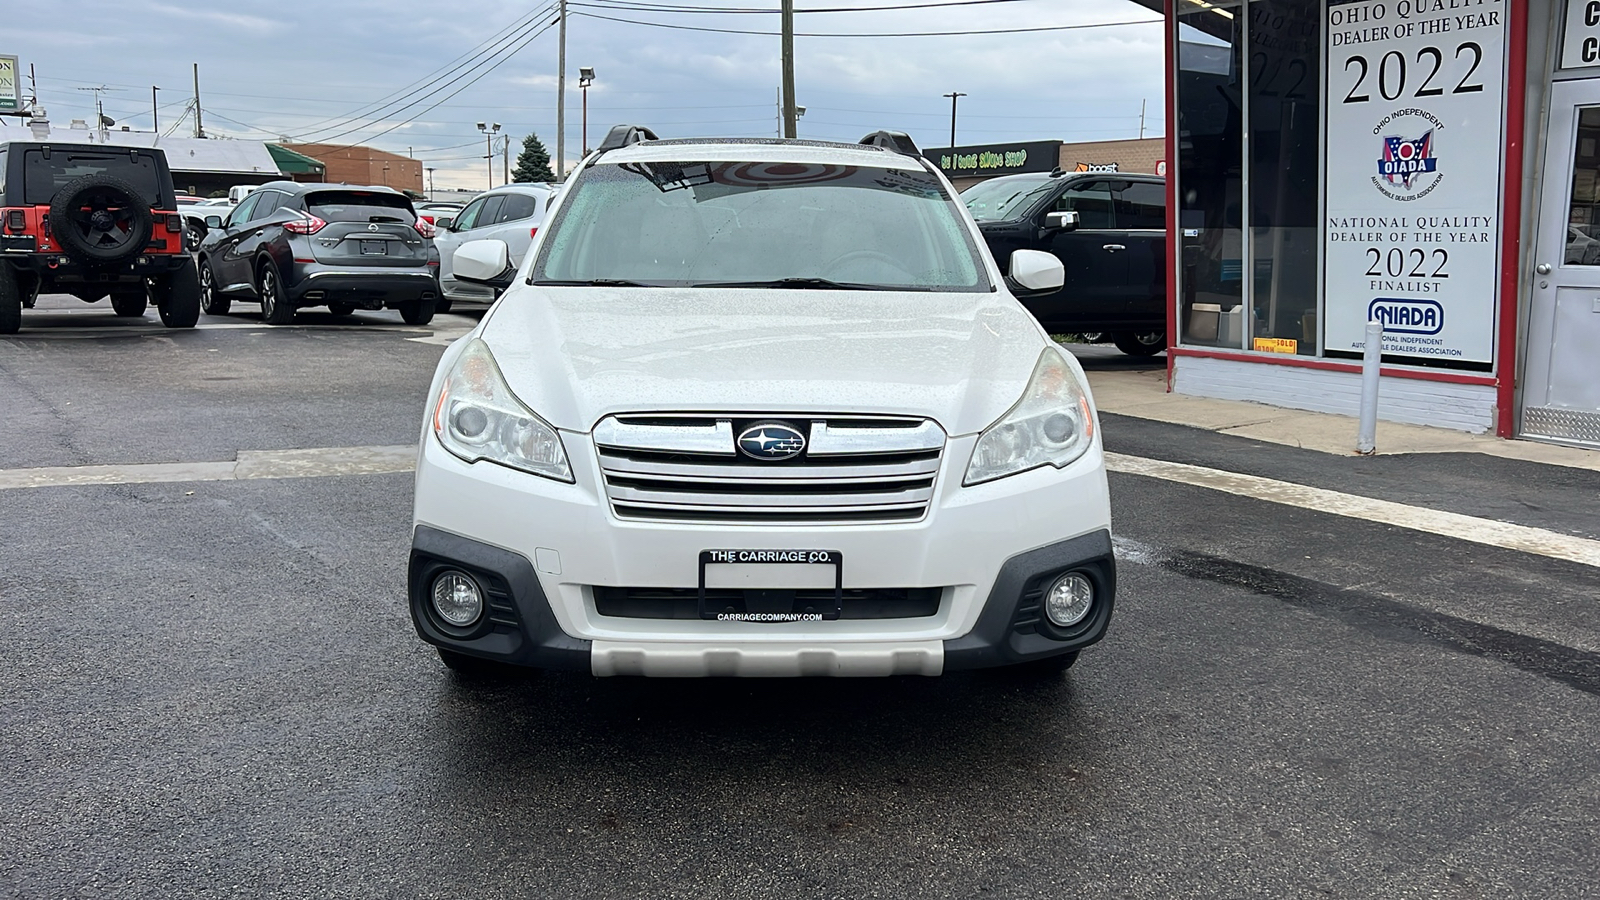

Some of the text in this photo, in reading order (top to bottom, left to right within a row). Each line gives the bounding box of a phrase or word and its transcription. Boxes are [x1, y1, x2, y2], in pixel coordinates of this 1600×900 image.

[1330, 4, 1386, 26] OHIO
[1332, 26, 1390, 47] DEALER
[1394, 22, 1415, 39] OF
[1418, 17, 1451, 36] THE
[1455, 11, 1500, 31] YEAR
[1343, 41, 1484, 104] 2022
[1372, 108, 1445, 135] OHIO INDEPENDENT
[1004, 148, 1027, 168] SHOP
[1088, 162, 1119, 173] boost
[1384, 159, 1427, 173] OIADA
[1371, 172, 1444, 202] AUTOMOBILE DEALERS ASSOCIATION
[1329, 216, 1493, 230] NATIONAL QUALITY
[1331, 232, 1489, 243] DEALER OF THE YEAR
[1364, 247, 1449, 279] 2022
[1370, 280, 1441, 293] FINALIST
[1374, 305, 1436, 328] NIADA
[1400, 336, 1443, 346] INDEPENDENT
[1390, 344, 1417, 353] DEALERS
[1418, 347, 1462, 356] ASSOCIATION
[709, 551, 832, 562] THE CARRIAGE CO.
[717, 613, 823, 621] CARRIAGECOMPANY.COM
